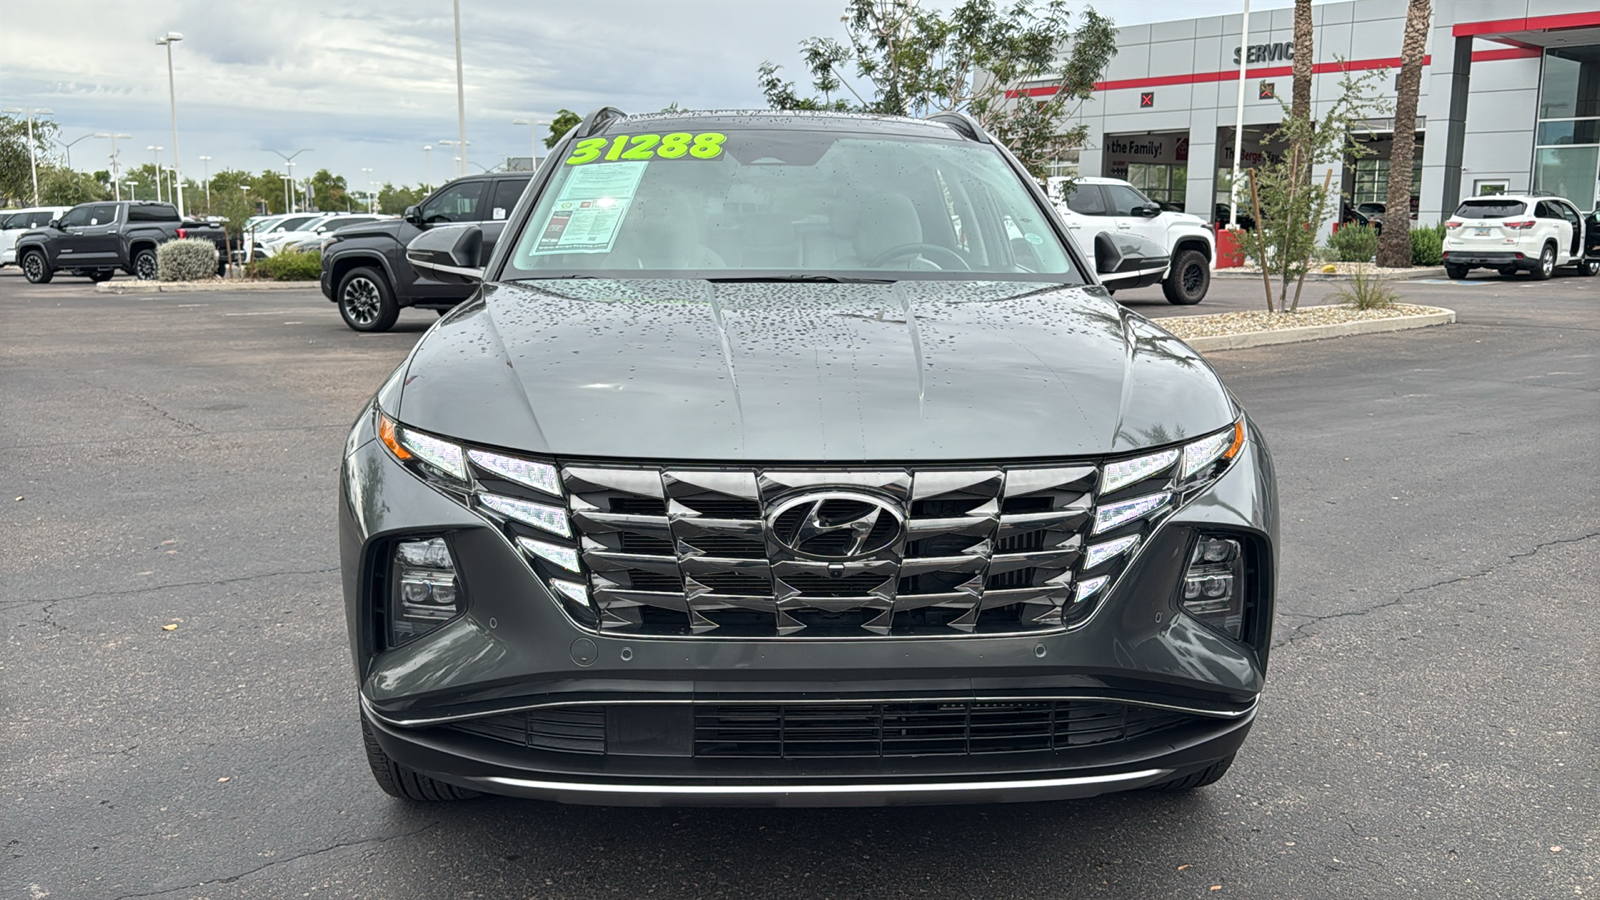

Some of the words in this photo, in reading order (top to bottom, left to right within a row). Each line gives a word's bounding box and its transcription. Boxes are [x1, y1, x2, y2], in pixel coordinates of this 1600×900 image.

[1233, 42, 1294, 64] SERVIC
[566, 132, 727, 165] 31288
[1111, 139, 1127, 153] the
[1129, 140, 1162, 158] Family!
[1225, 147, 1236, 159] Th
[1241, 148, 1262, 164] Berge
